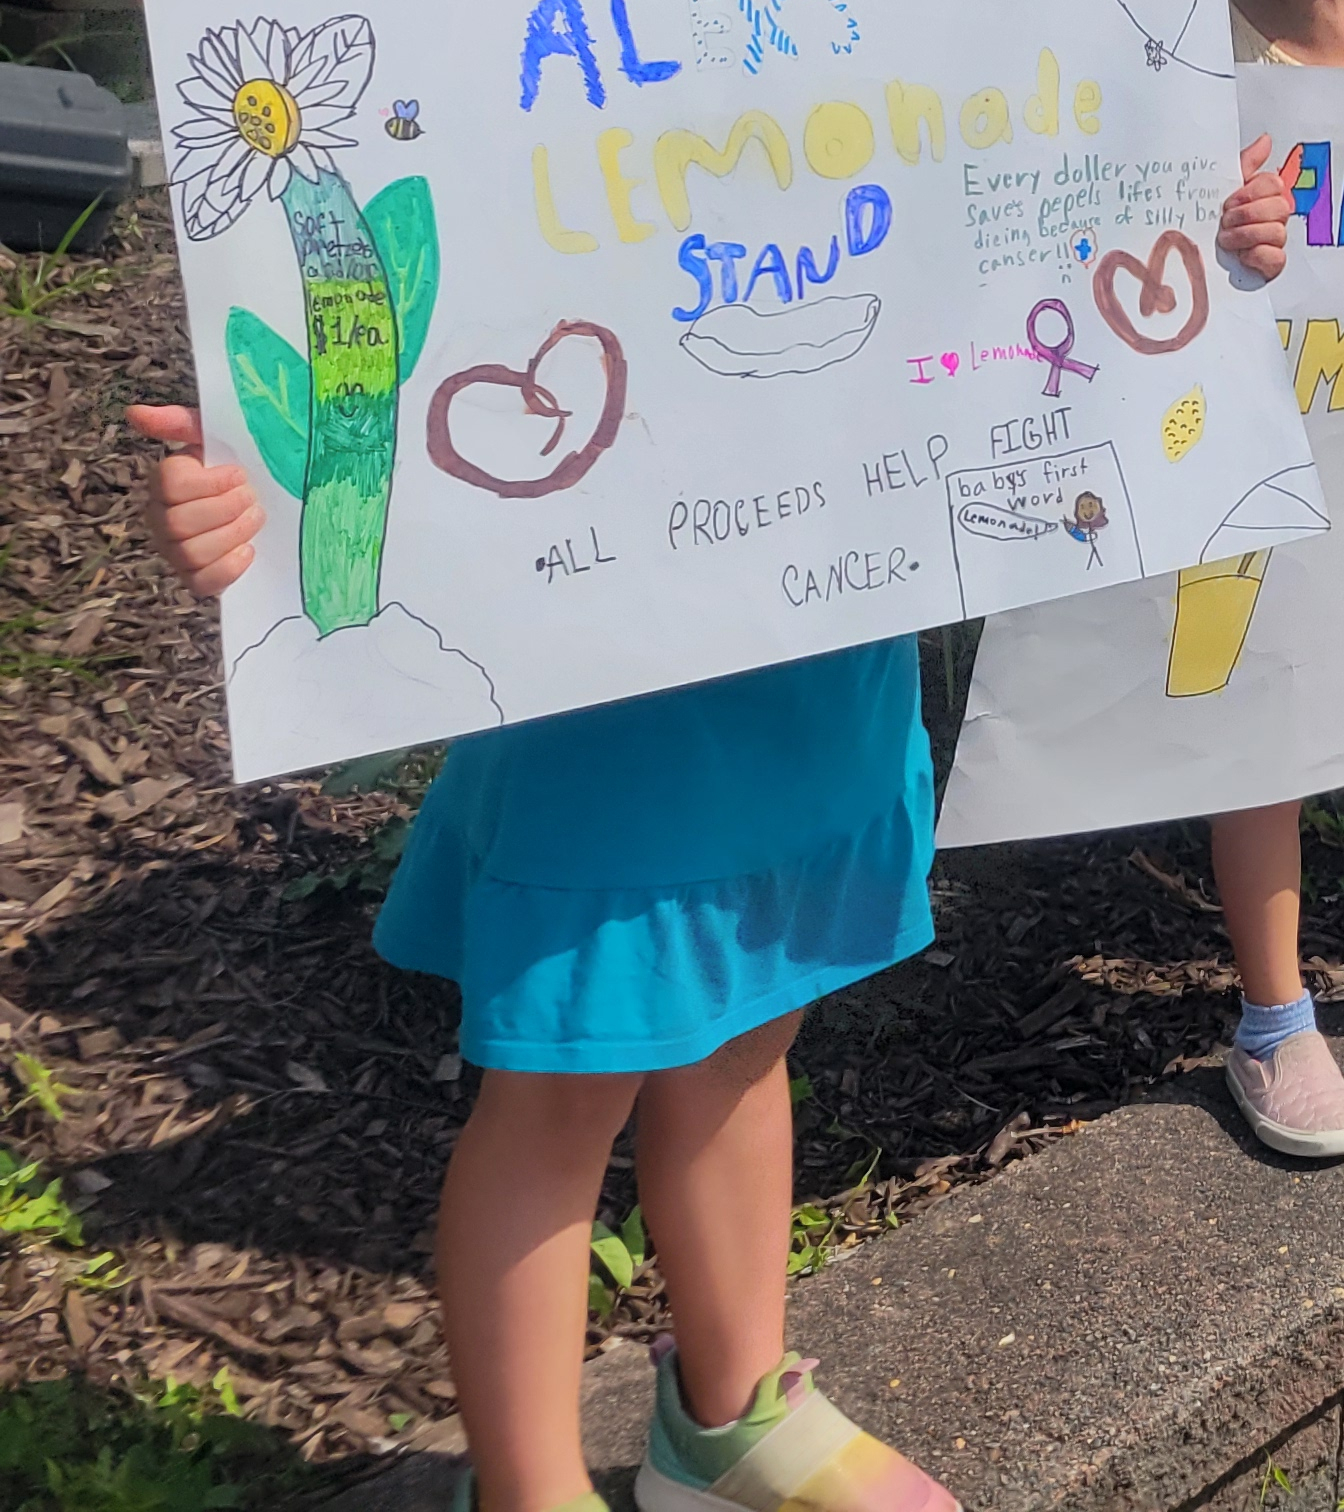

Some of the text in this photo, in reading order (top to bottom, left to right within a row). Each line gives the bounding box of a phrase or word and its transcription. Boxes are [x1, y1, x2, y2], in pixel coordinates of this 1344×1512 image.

[963, 152, 1218, 196] Every doller you give
[1118, 180, 1163, 205] lifes
[1176, 183, 1220, 202] from
[1115, 206, 1134, 226] of
[1145, 206, 1185, 229] silly
[1195, 205, 1223, 224] ba
[672, 184, 893, 322] STAND
[906, 354, 934, 384] I
[668, 481, 826, 551] PROCEEDS
[862, 434, 949, 497] HELP
[990, 406, 1073, 460] FIGHT
[1044, 457, 1089, 484] first
[1007, 487, 1064, 512] word
